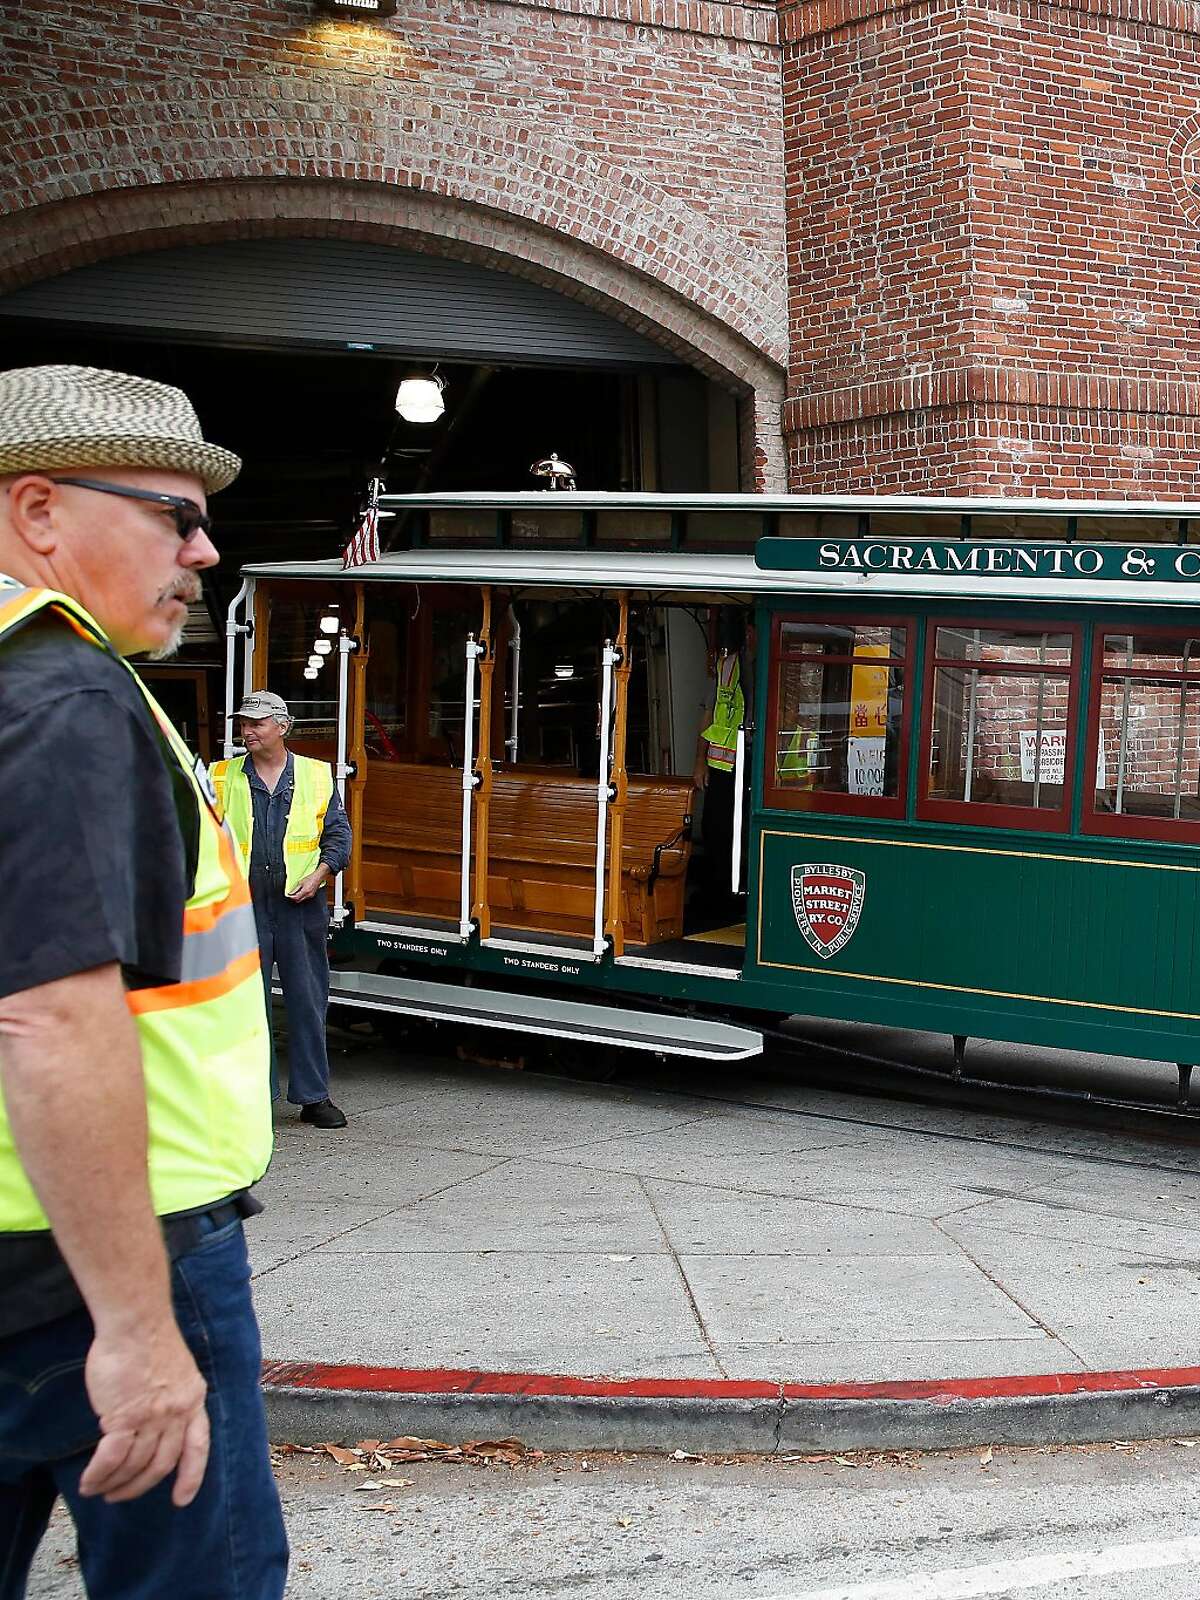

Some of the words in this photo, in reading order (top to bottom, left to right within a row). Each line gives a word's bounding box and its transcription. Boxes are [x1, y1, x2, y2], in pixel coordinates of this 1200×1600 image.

[818, 543, 1104, 574] SACRAMENTO
[1120, 548, 1156, 576] &
[803, 865, 855, 879] BYLLESBY
[803, 885, 852, 899] MARKET
[805, 899, 849, 912] STREET
[794, 877, 811, 935] PIONEERS
[812, 939, 823, 951] IN
[828, 924, 853, 953] PUBLIC
[849, 884, 863, 925] SERVICE
[376, 939, 393, 948] TWO
[393, 941, 429, 953] STANDEES
[430, 947, 448, 956] ONLY
[503, 957, 520, 966] TWO
[521, 959, 559, 972] STANDEES
[561, 965, 580, 975] ONLY
